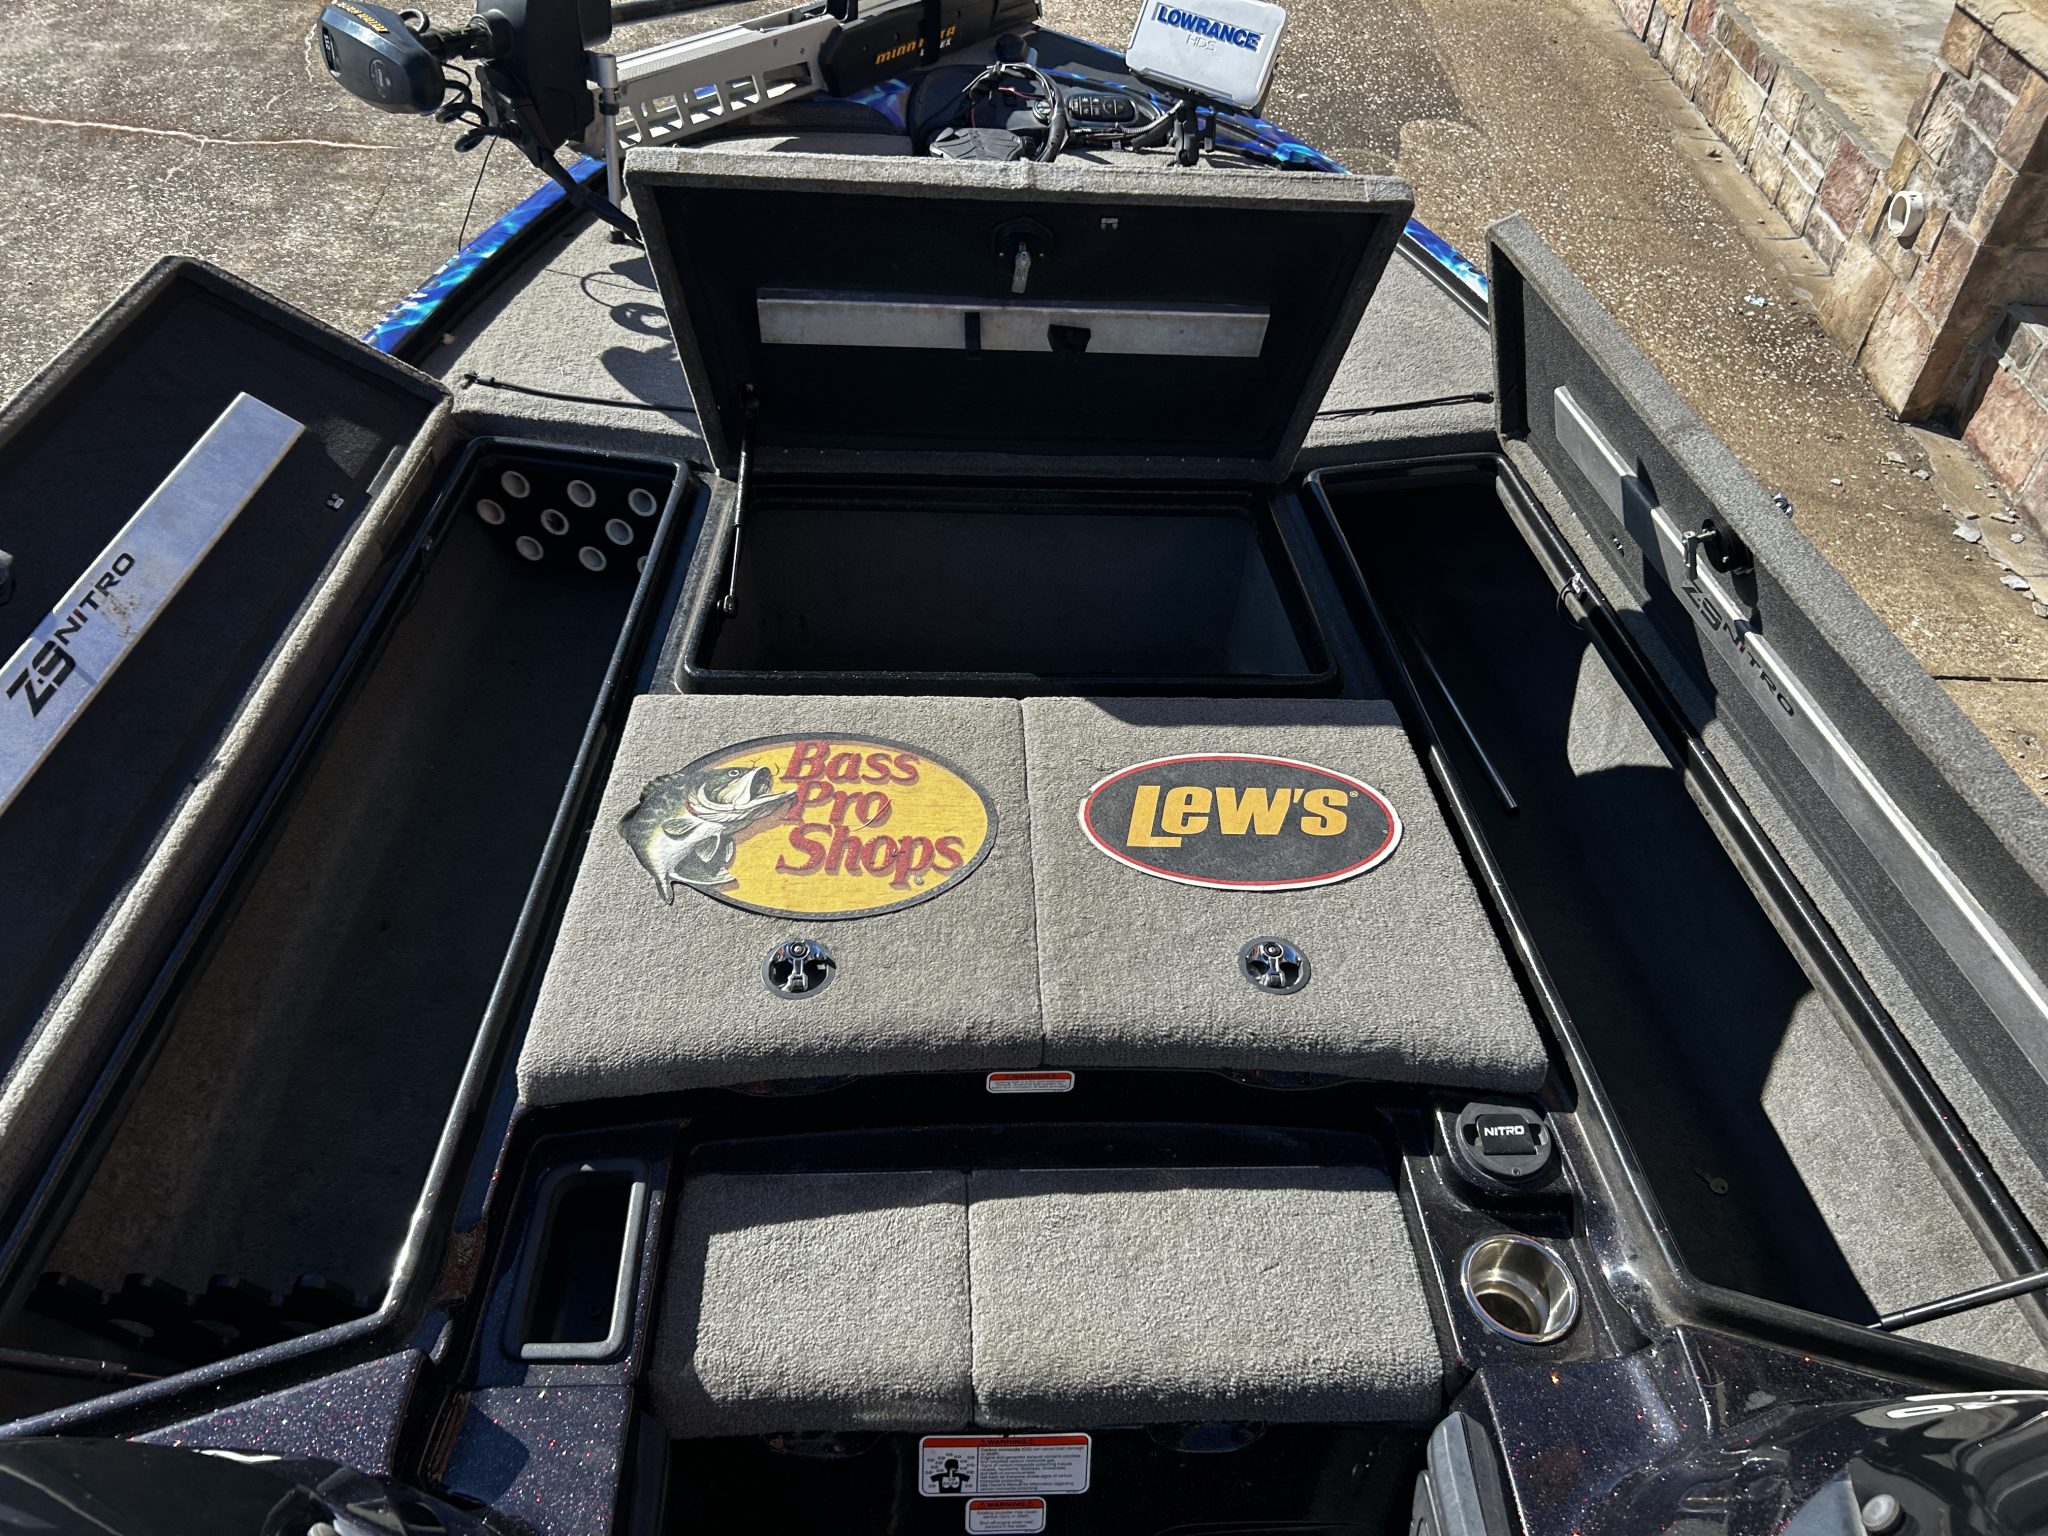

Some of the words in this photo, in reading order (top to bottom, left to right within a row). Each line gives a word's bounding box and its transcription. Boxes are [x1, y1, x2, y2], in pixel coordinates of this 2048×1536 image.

[1157, 5, 1261, 52] LOWRANCE
[54, 552, 136, 646] NITRO
[1722, 622, 1795, 717] NITRO
[779, 740, 920, 786] Bass
[779, 780, 892, 828] Pro
[775, 822, 965, 890] Shops
[1483, 1125, 1525, 1137] NITRO
